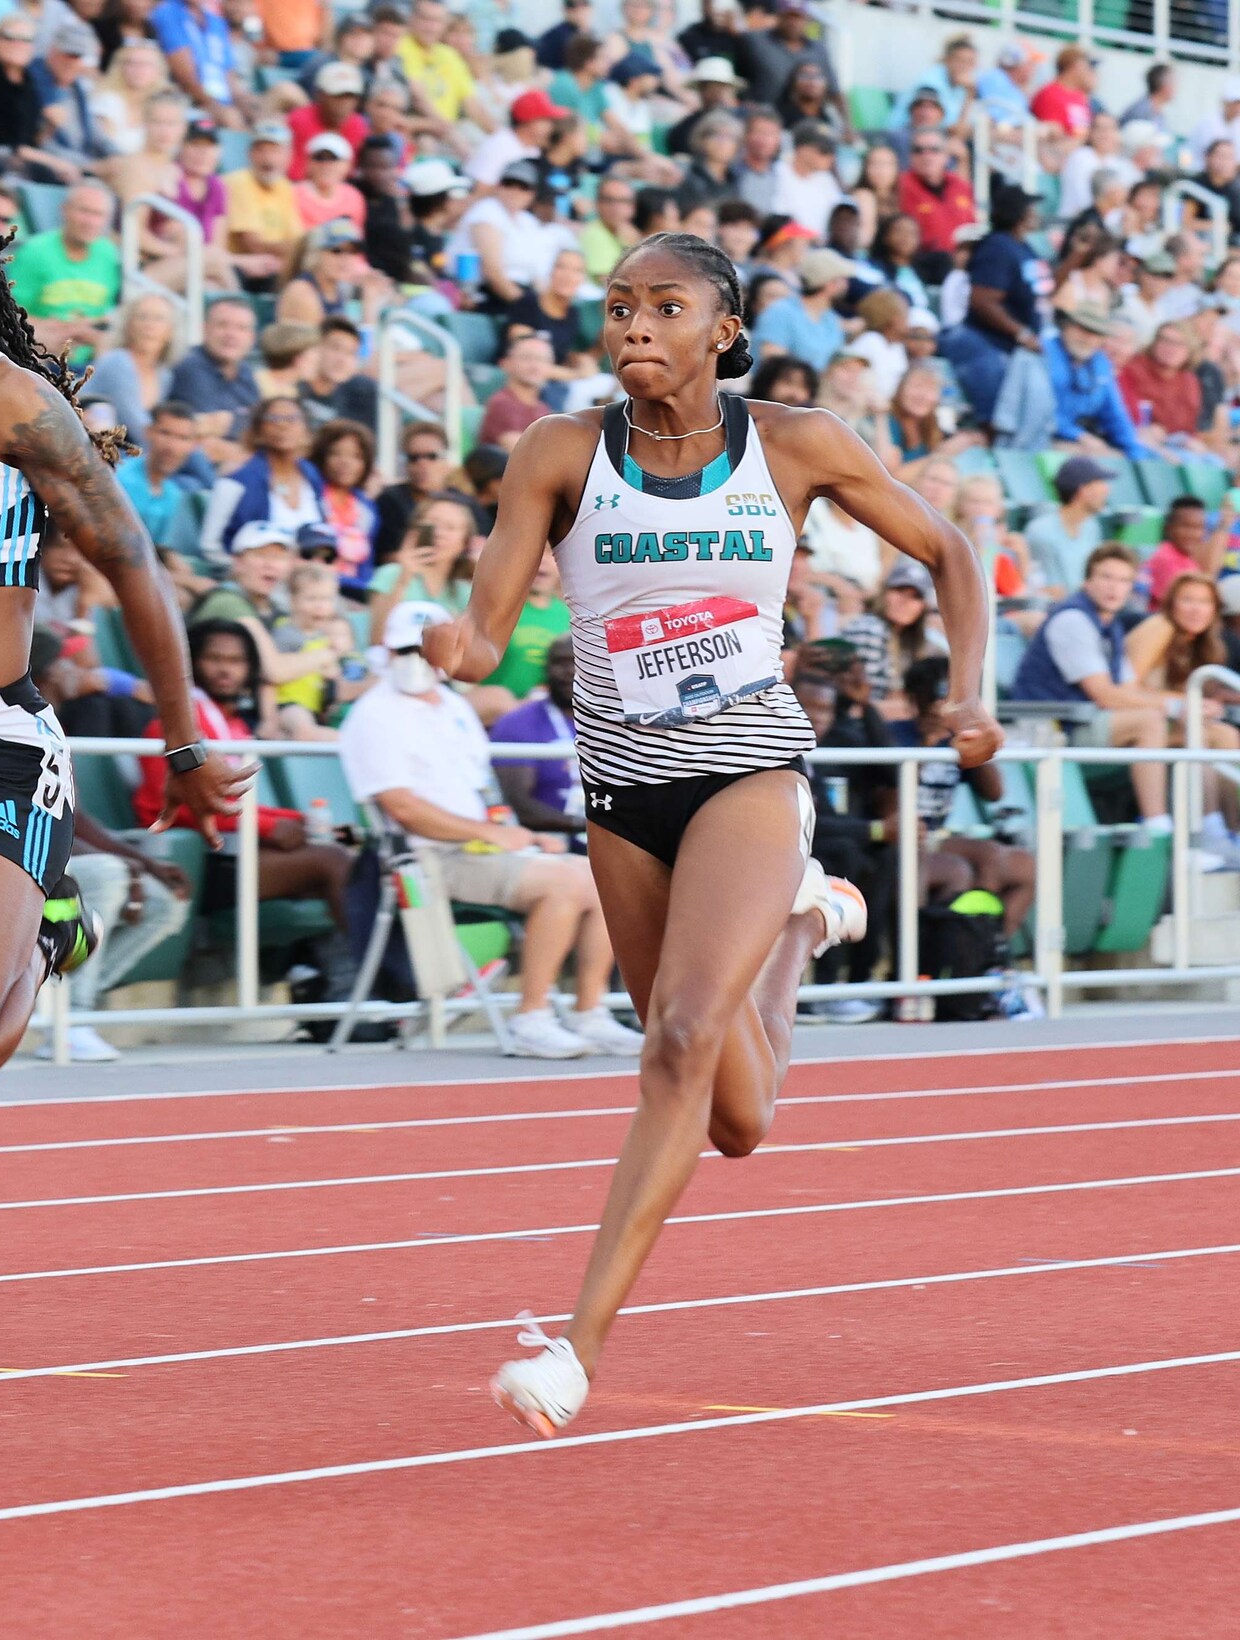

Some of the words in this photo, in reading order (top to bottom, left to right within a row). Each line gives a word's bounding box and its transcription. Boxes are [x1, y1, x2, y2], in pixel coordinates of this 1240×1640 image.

[725, 493, 777, 517] SBC
[594, 530, 773, 564] COASTAL
[664, 611, 714, 630] TOYOTA
[636, 629, 743, 680] JEFFERSON
